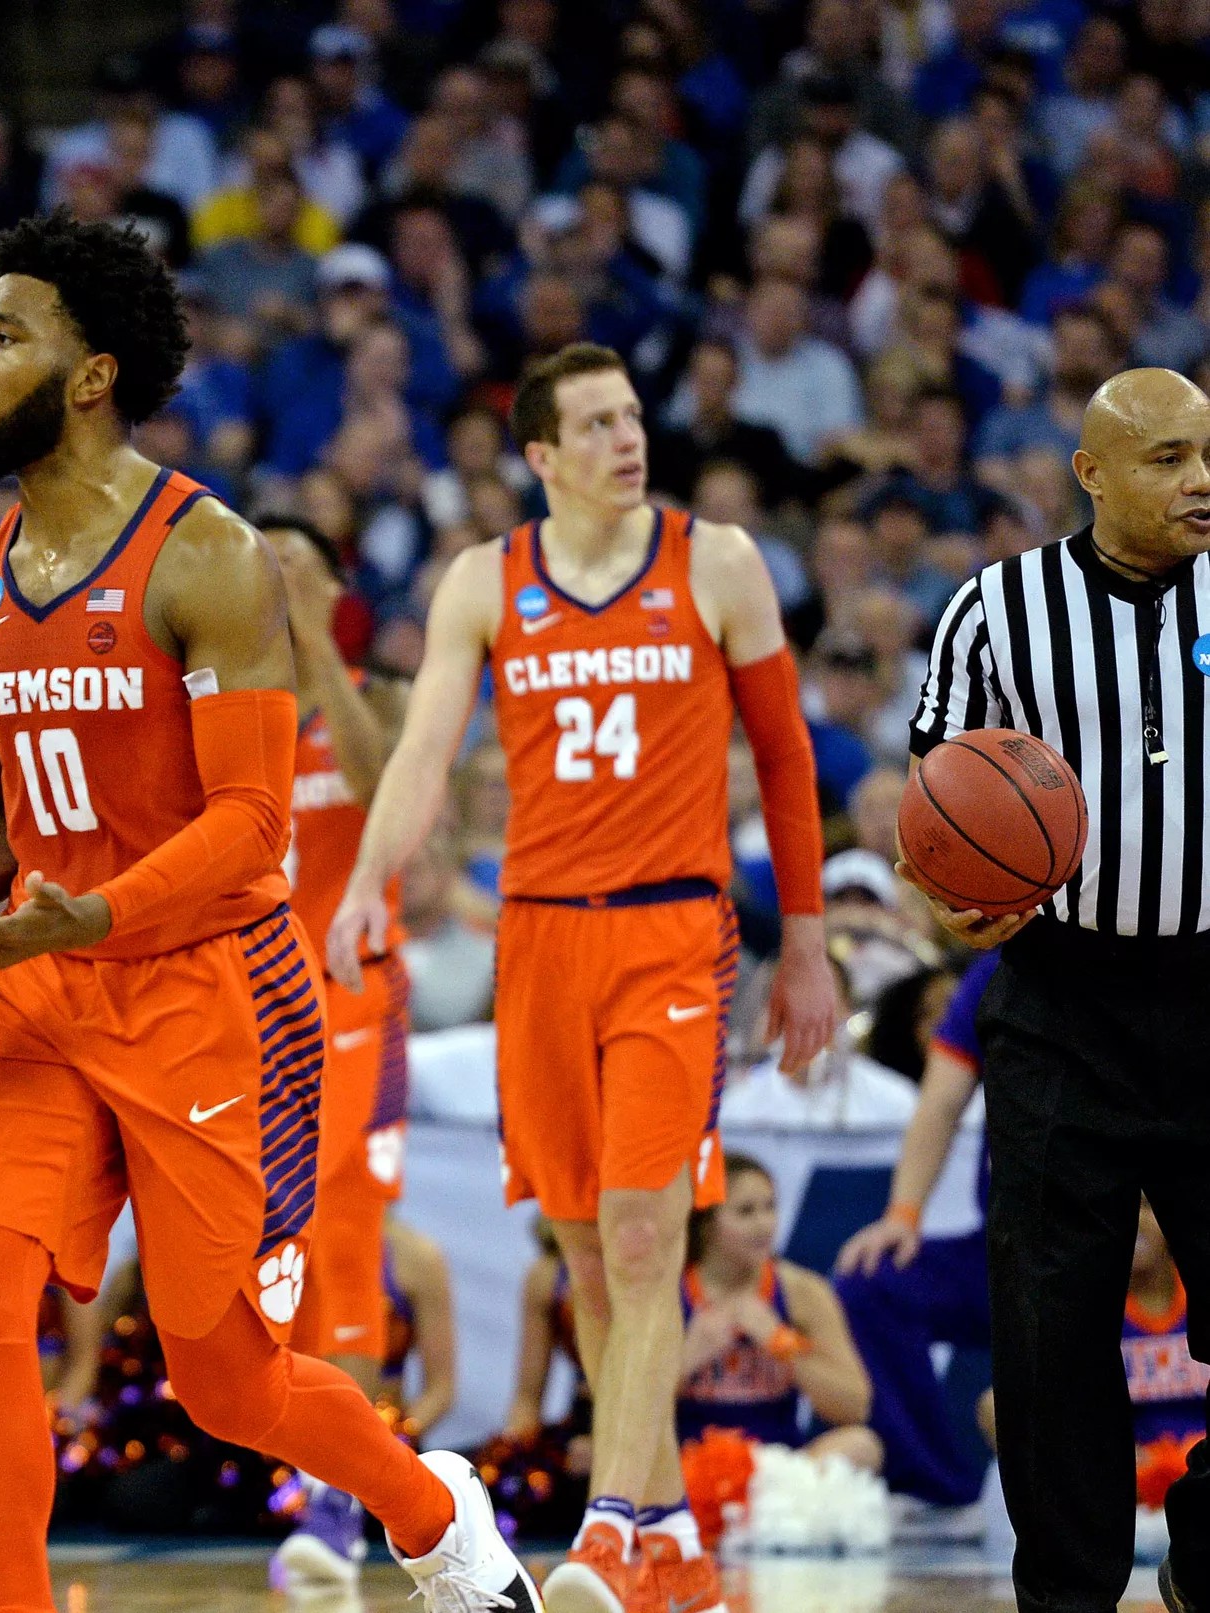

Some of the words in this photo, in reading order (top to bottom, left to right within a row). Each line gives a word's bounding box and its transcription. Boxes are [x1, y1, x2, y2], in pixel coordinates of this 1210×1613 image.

[503, 644, 693, 696] CLEMSON
[14, 727, 100, 837] 10
[553, 692, 642, 782] 24
